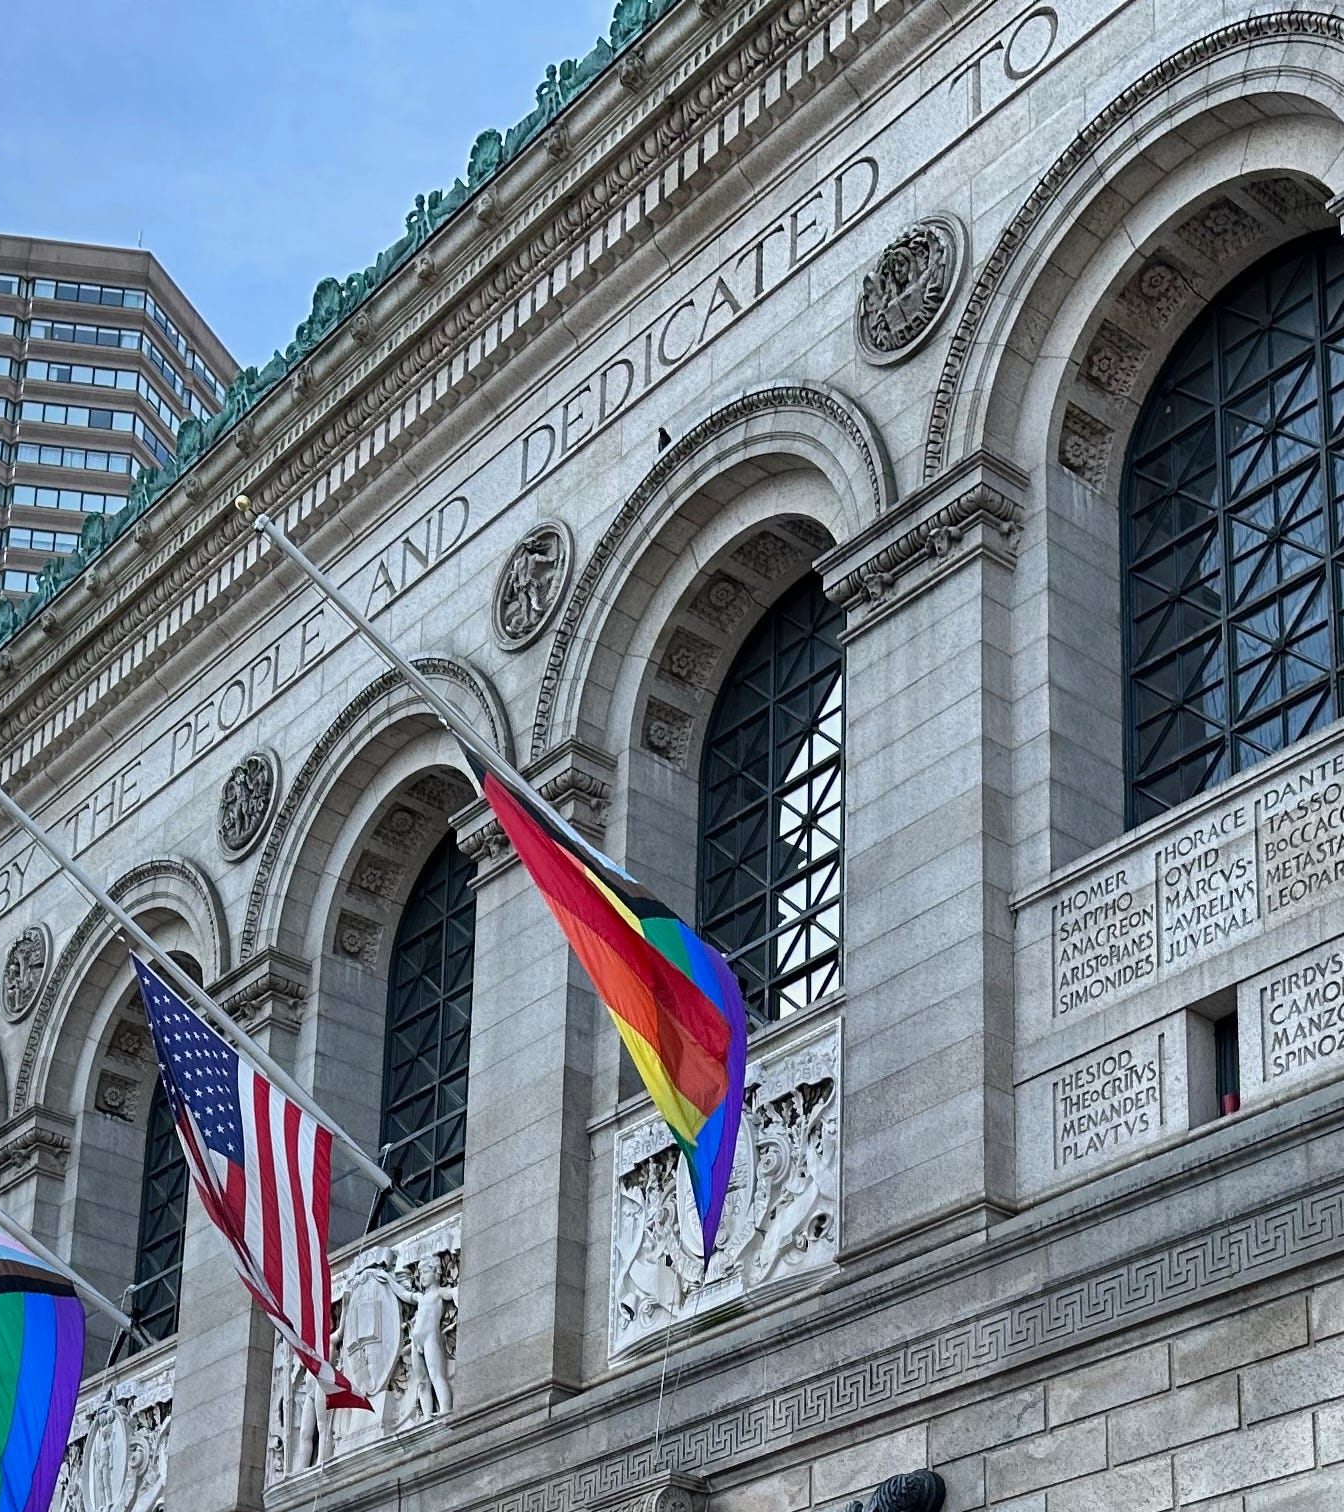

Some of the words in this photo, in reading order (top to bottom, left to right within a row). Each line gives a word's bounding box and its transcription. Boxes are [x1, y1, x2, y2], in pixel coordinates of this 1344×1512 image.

[64, 760, 141, 853] THE
[169, 608, 326, 777] PEOPLE
[364, 495, 470, 617] AND
[520, 156, 879, 490] DEDICATED
[949, 6, 1058, 123] TO
[1164, 806, 1247, 864] HORACE
[1265, 783, 1342, 834] TASSO
[1060, 870, 1128, 917] HOMER
[1165, 848, 1219, 887] OVID
[1059, 892, 1133, 942] SAPPHO
[1059, 904, 1154, 967] ANACREON
[1165, 907, 1254, 964] JUVENAL
[1059, 954, 1154, 1014] SIMONIDES
[1061, 1049, 1132, 1096] HESIOD
[1061, 1086, 1158, 1143] MENANDER
[1063, 1112, 1149, 1166] PLAVTVS
